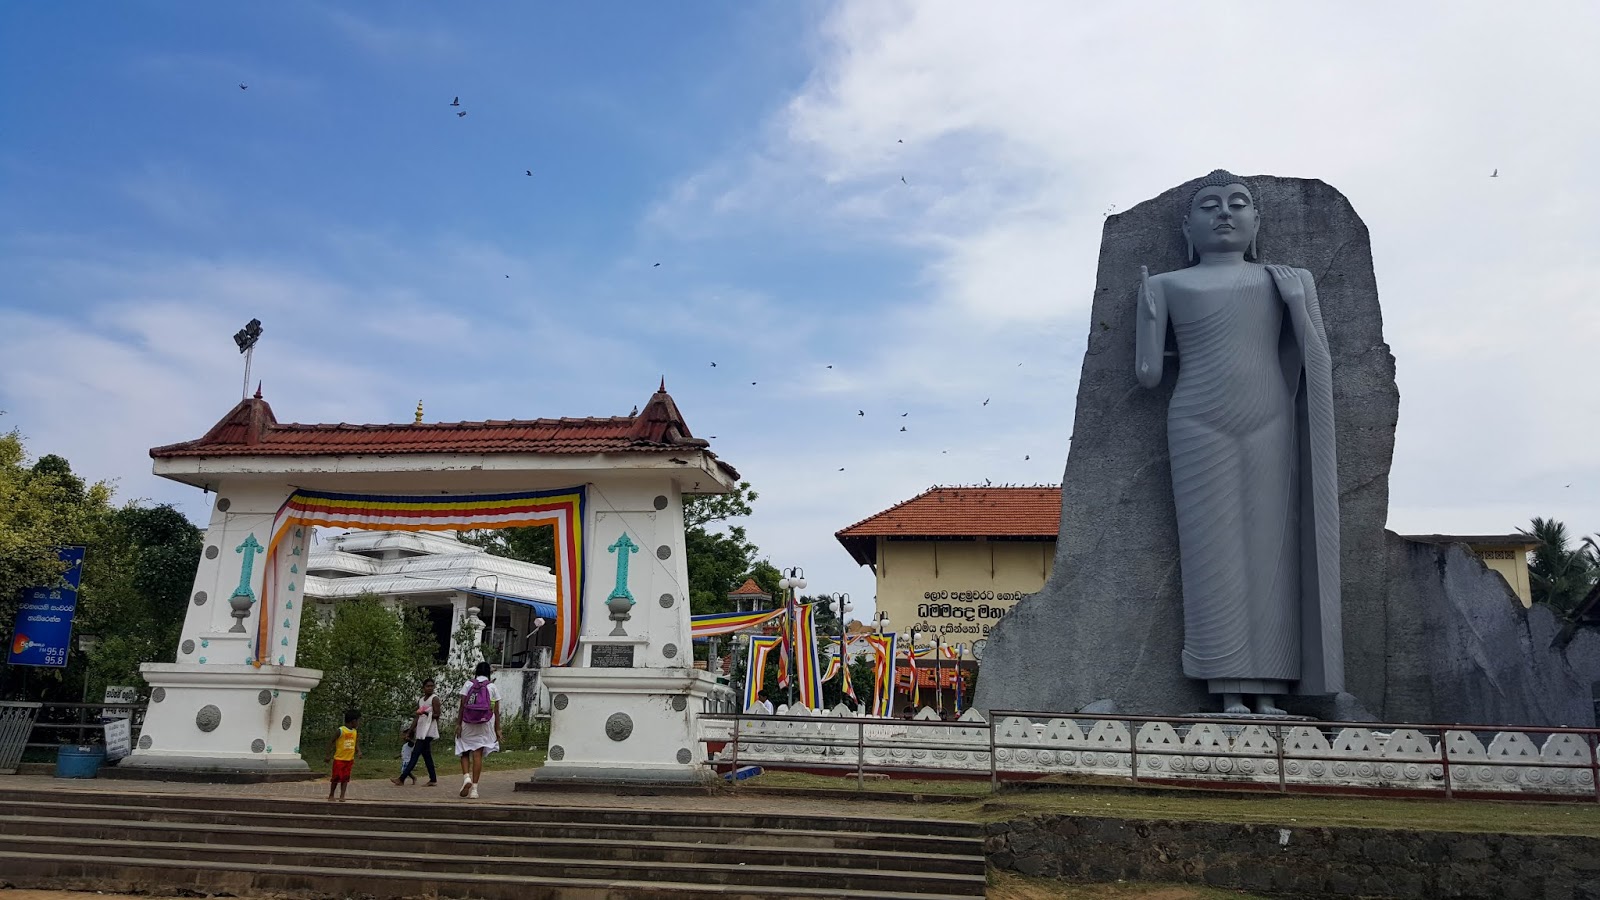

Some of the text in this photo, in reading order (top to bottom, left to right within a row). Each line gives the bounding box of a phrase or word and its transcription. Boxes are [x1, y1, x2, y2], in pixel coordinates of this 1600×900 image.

[924, 590, 948, 601] ලොව
[951, 590, 994, 602] පළමුවරට
[46, 647, 65, 656] 95.6
[44, 656, 63, 665] 95.8
